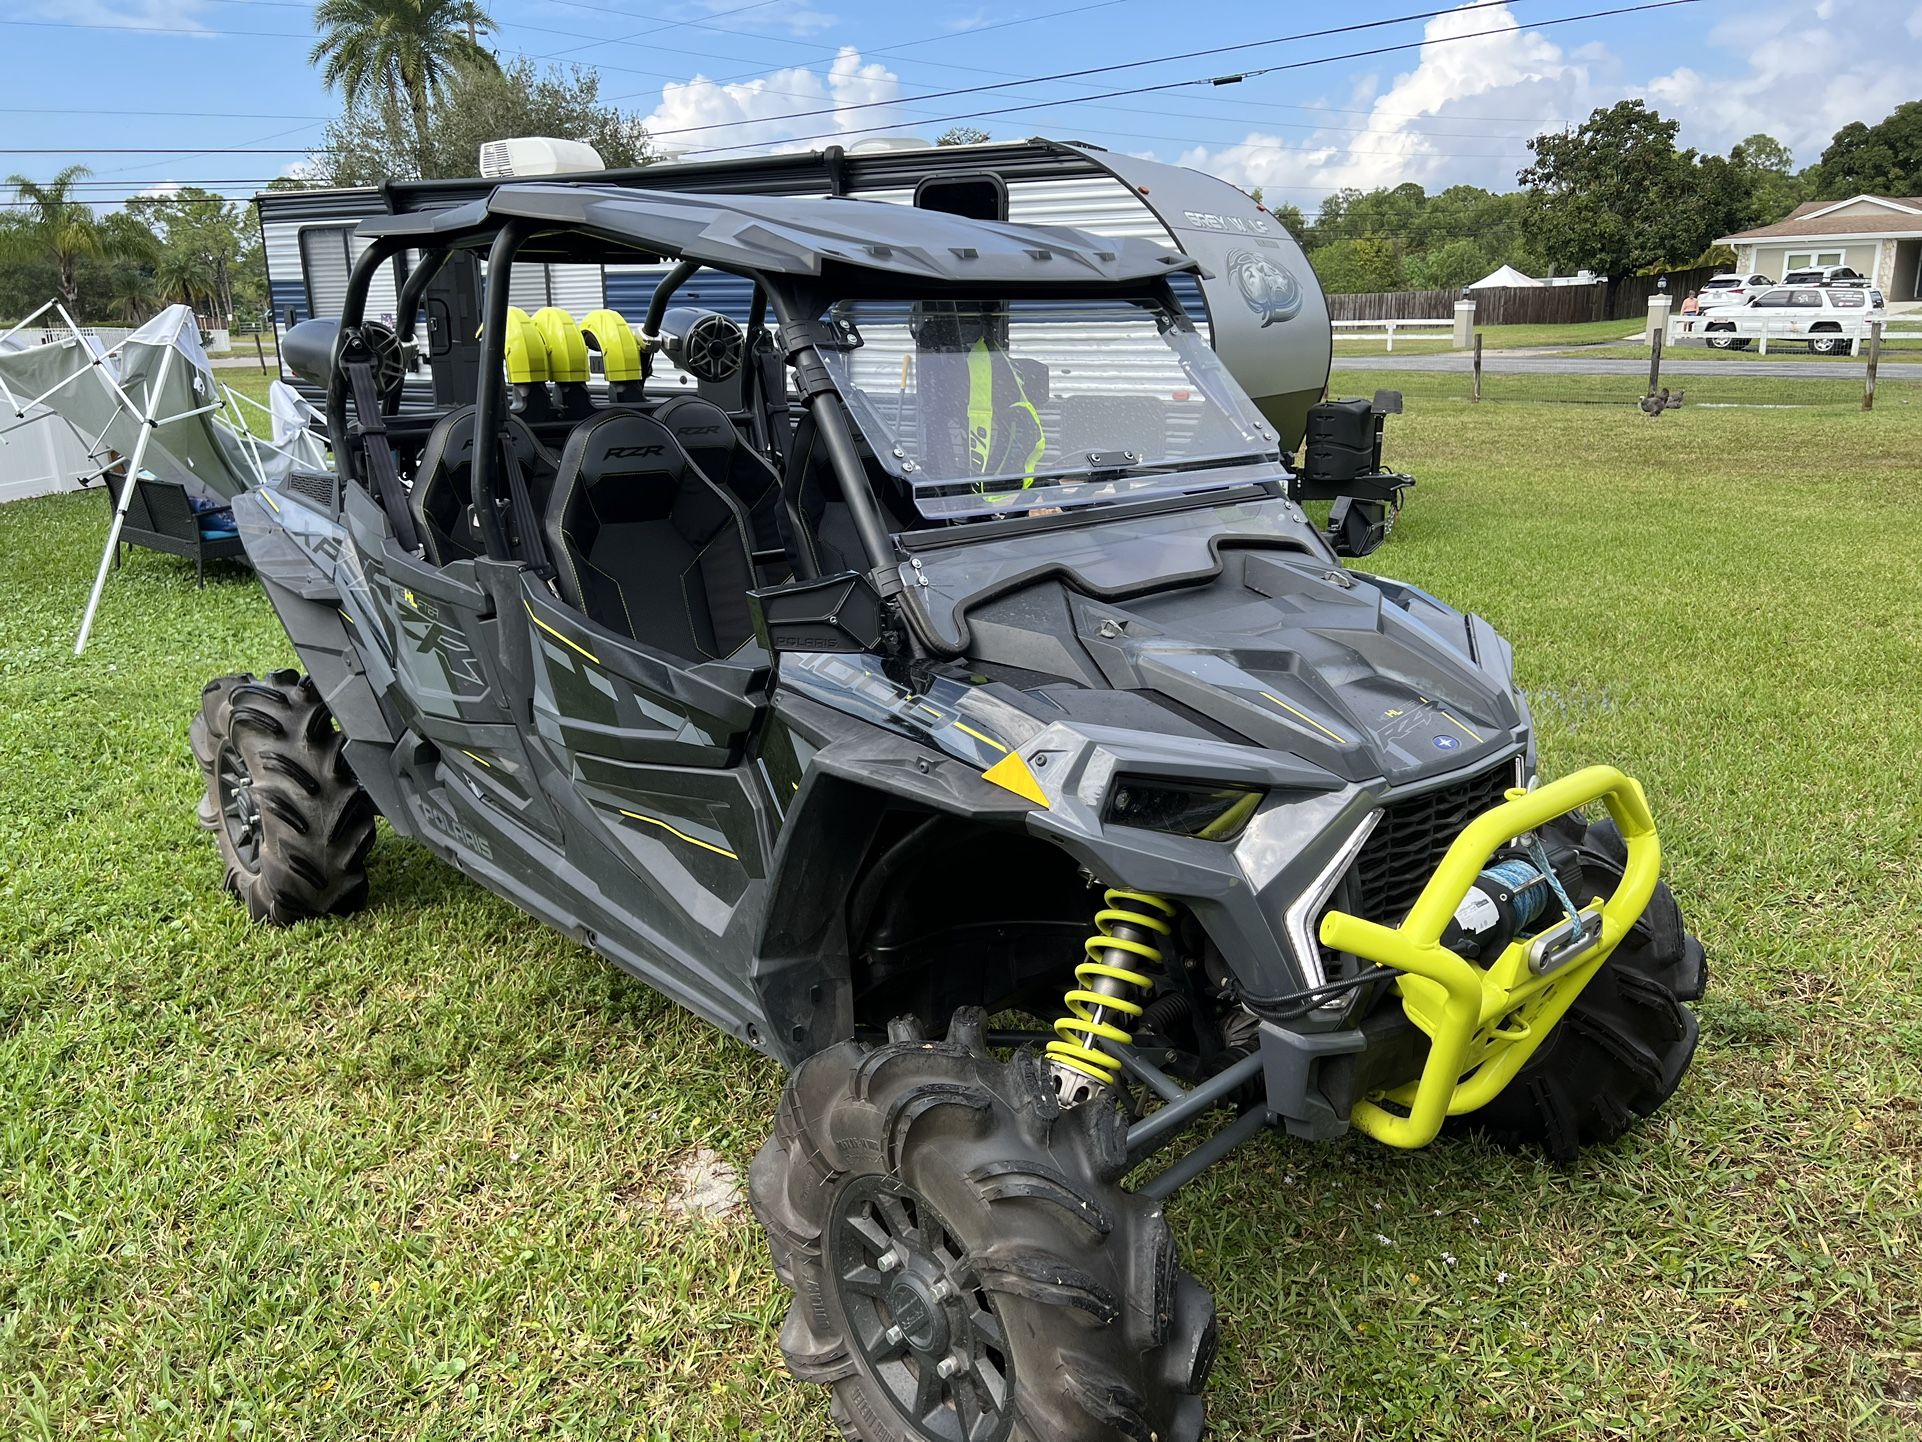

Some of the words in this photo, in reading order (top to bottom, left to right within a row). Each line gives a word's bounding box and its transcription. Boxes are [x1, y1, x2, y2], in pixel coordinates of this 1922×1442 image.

[1227, 216, 1269, 233] WLF
[677, 425, 721, 440] RZR
[602, 444, 666, 462] RZR
[775, 636, 839, 648] POLARIS
[421, 802, 494, 860] POLARIS
